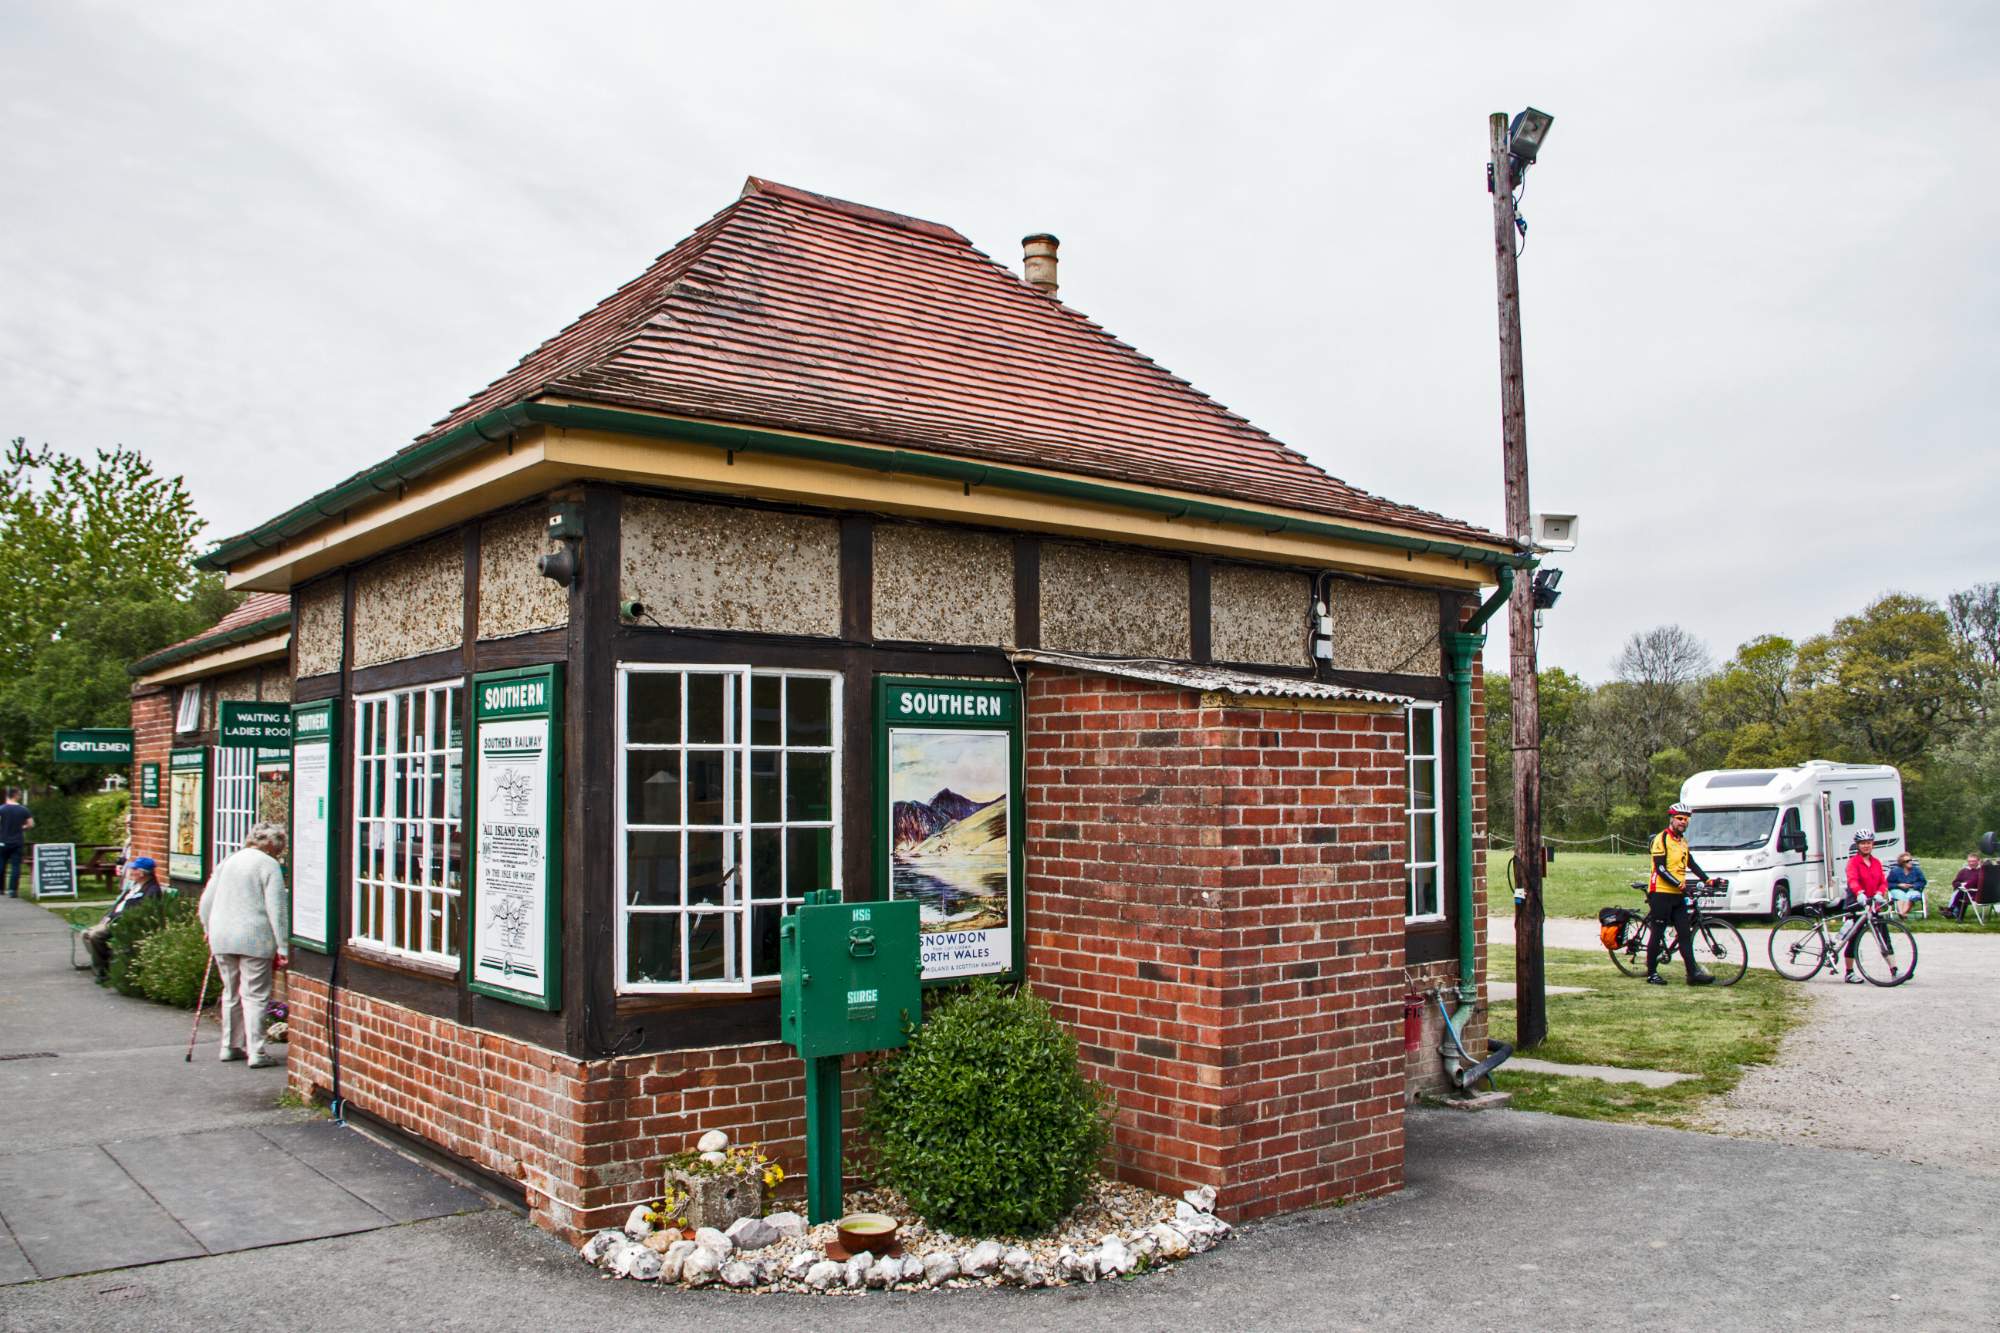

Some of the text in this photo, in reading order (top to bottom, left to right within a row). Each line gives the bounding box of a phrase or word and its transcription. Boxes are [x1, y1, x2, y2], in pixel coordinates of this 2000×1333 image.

[485, 682, 544, 710] SOUTHERN
[900, 692, 1001, 716] SOUTHERN
[237, 713, 290, 723] WAITING &
[225, 727, 291, 737] LADIES ROO
[60, 741, 130, 752] GENTLEMEN
[484, 736, 542, 748] SOUTHERN RAILWAY
[919, 931, 986, 947] SNOWDON
[922, 948, 990, 963] ORTH WALES
[847, 989, 878, 1004] SURGE
